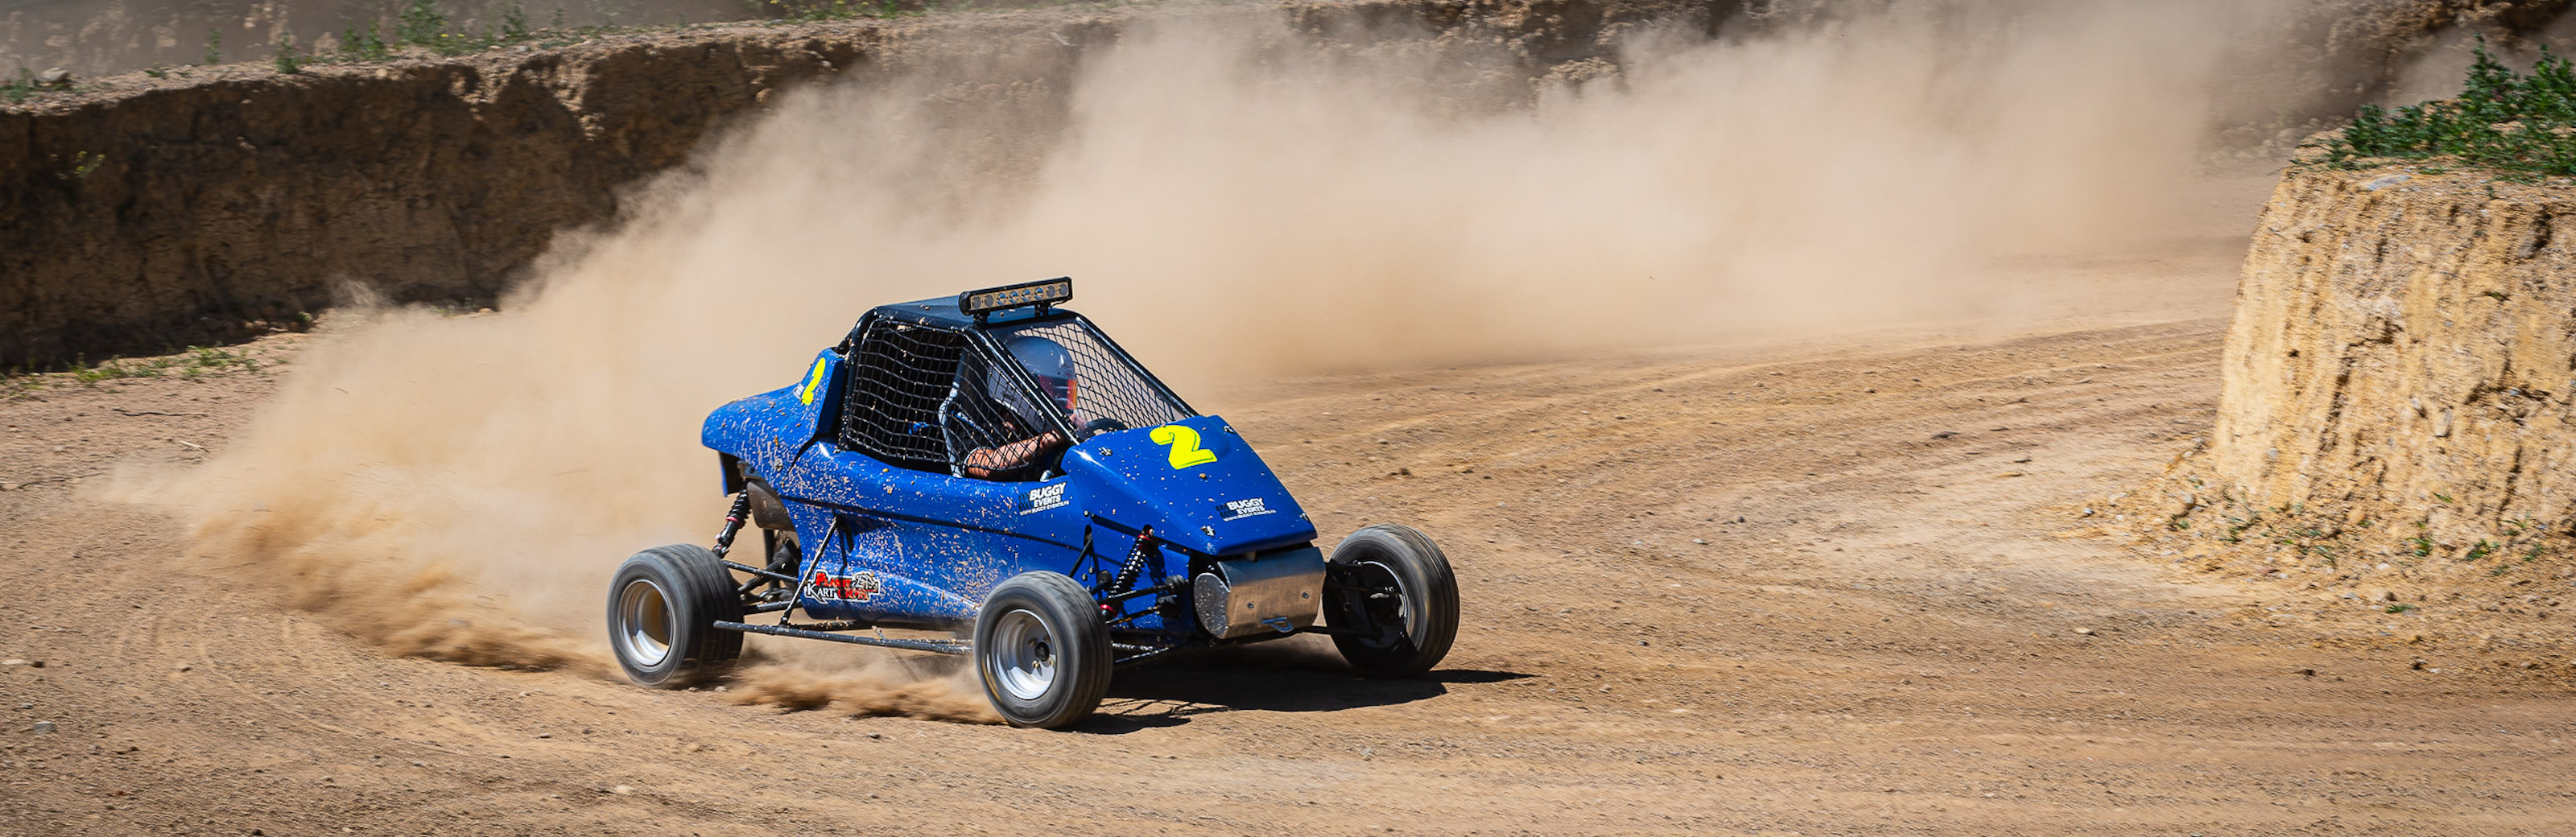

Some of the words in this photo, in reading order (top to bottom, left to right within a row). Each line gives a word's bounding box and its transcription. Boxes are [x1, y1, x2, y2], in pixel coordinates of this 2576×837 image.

[802, 357, 826, 406] 2
[1149, 424, 1217, 470] 2
[1030, 482, 1067, 501] BUGGY
[1034, 494, 1061, 508] EVENTS
[1226, 497, 1265, 511] BUGGY
[1236, 505, 1265, 515] EVENTS
